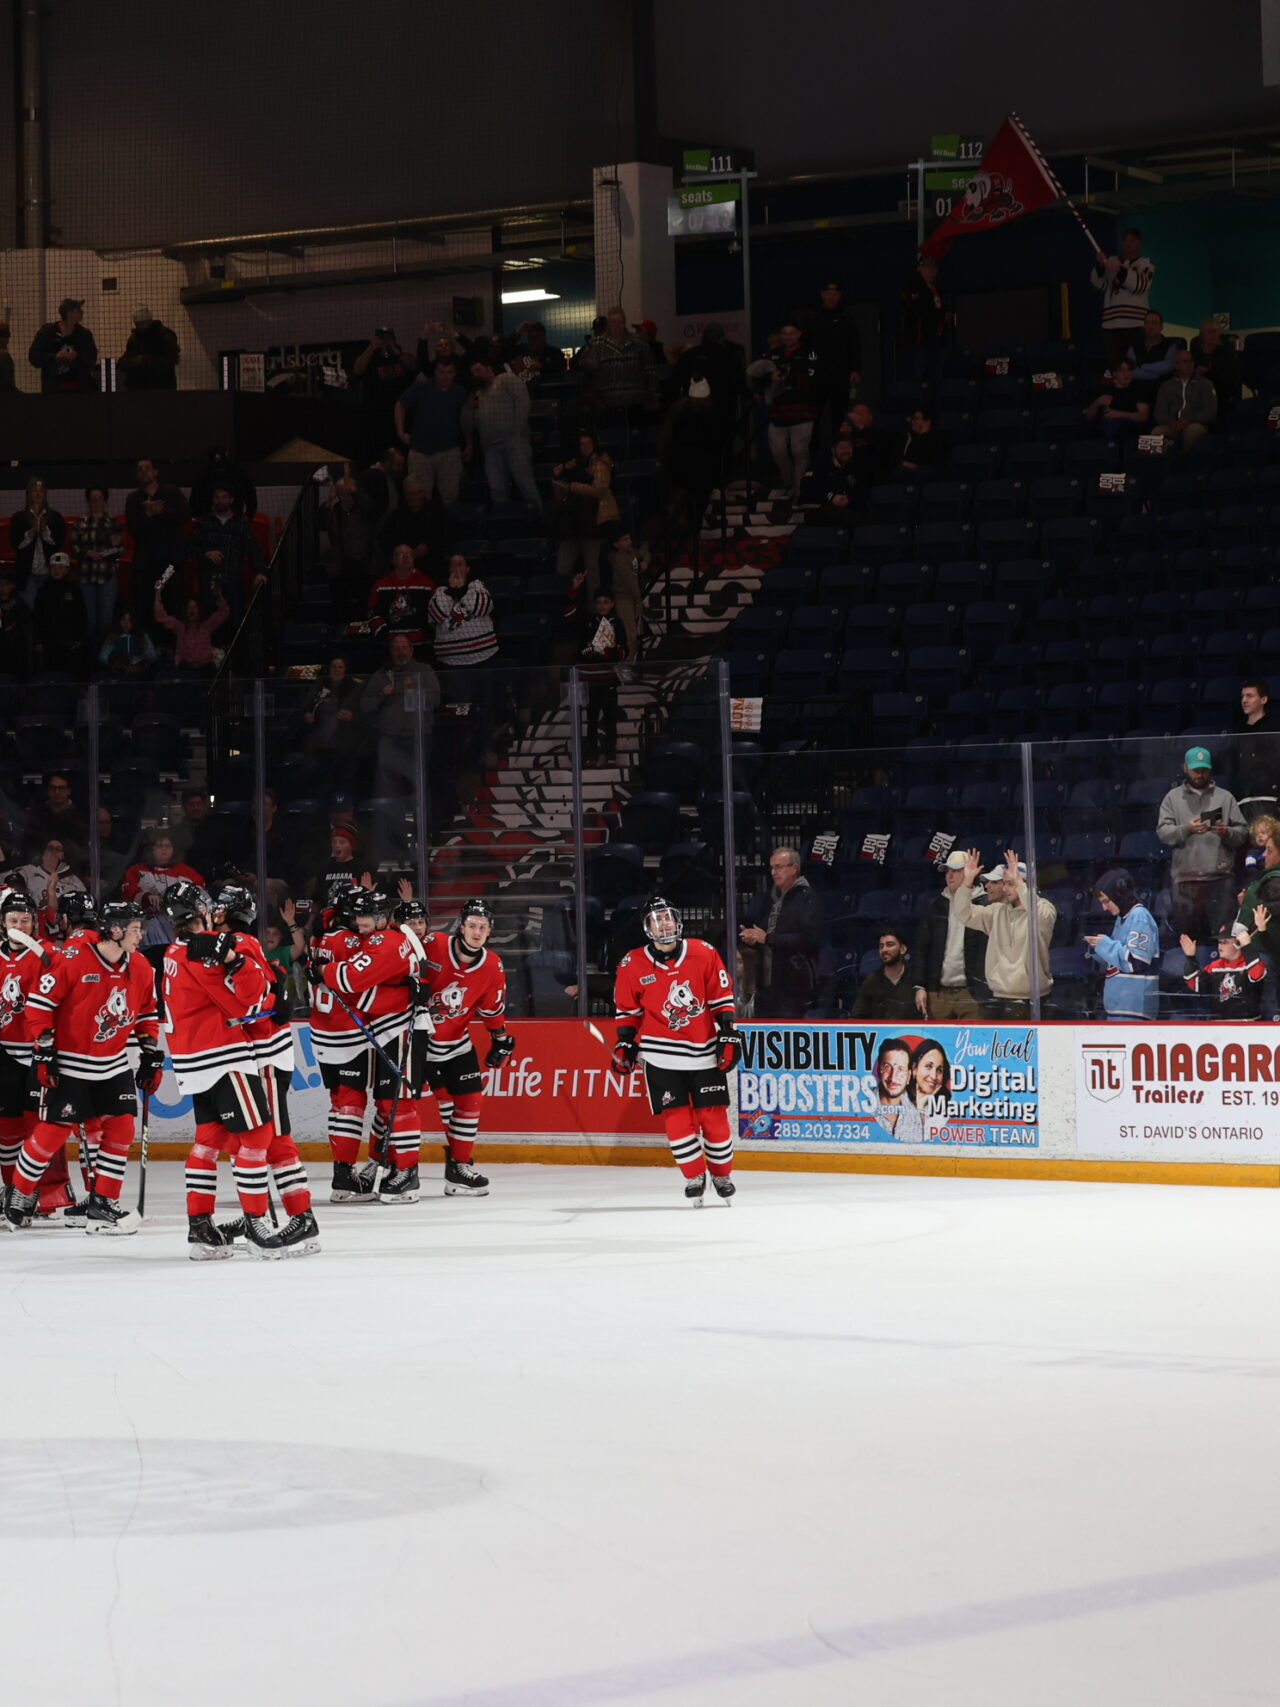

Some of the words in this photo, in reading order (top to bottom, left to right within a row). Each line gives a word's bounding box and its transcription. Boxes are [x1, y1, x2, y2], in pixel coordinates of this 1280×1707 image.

[960, 142, 983, 159] 112
[710, 155, 733, 173] 111
[681, 190, 713, 205] seats
[1127, 930, 1150, 951] 22
[740, 1031, 877, 1071] VISIBILITY
[954, 1029, 990, 1064] Your
[950, 1064, 1038, 1099] Digital
[739, 1071, 879, 1114] BOOSTERS
[1132, 1085, 1204, 1104] Trailers
[1221, 1090, 1256, 1106] EST.
[929, 1095, 1037, 1124] Marketing
[774, 1122, 870, 1140] 289.203.7334
[929, 1126, 986, 1142] POWER
[989, 1127, 1036, 1145] TEAM
[1119, 1126, 1139, 1139] ST.
[1143, 1126, 1197, 1140] DAVID'S
[1201, 1126, 1264, 1140] ONTARIO
